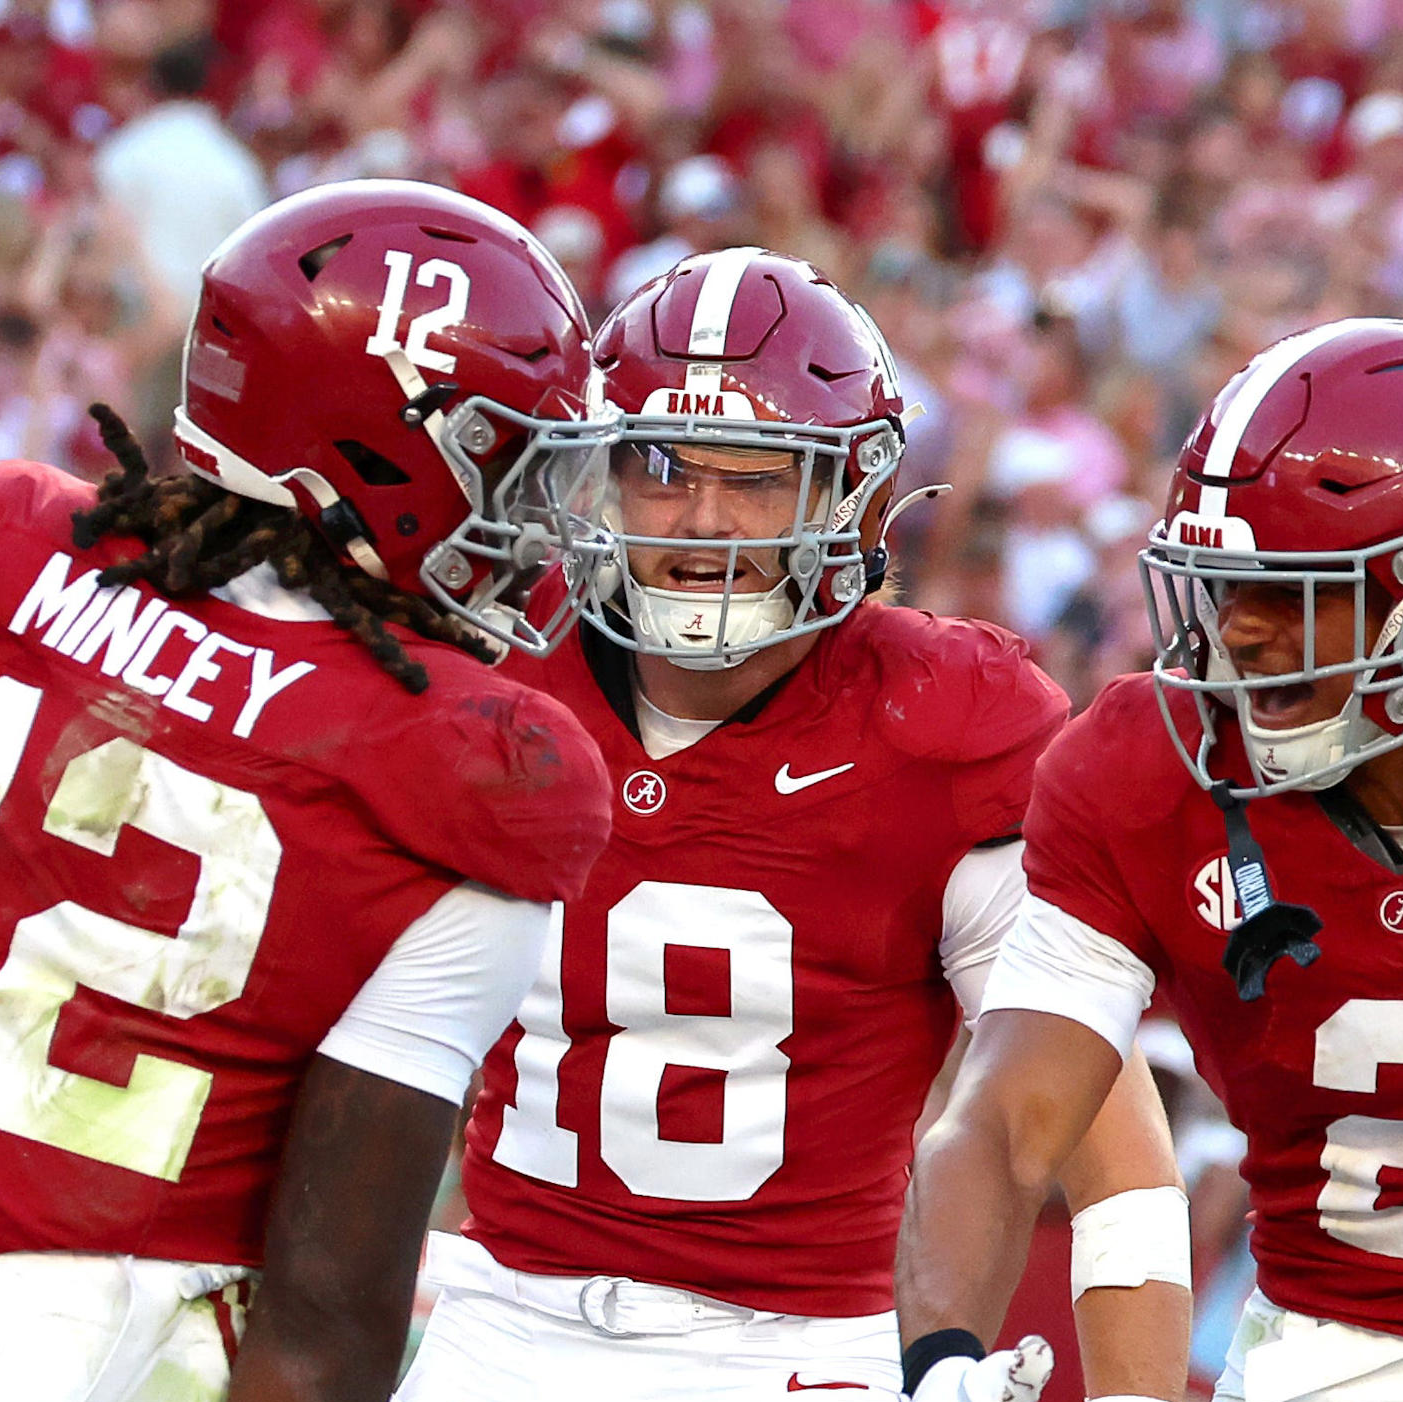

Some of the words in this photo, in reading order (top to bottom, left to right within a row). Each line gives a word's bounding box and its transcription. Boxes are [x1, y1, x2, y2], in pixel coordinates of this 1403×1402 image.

[366, 249, 470, 374] 12
[667, 392, 724, 416] BAMA
[8, 551, 317, 739] MINCEY
[492, 880, 794, 1202] 18
